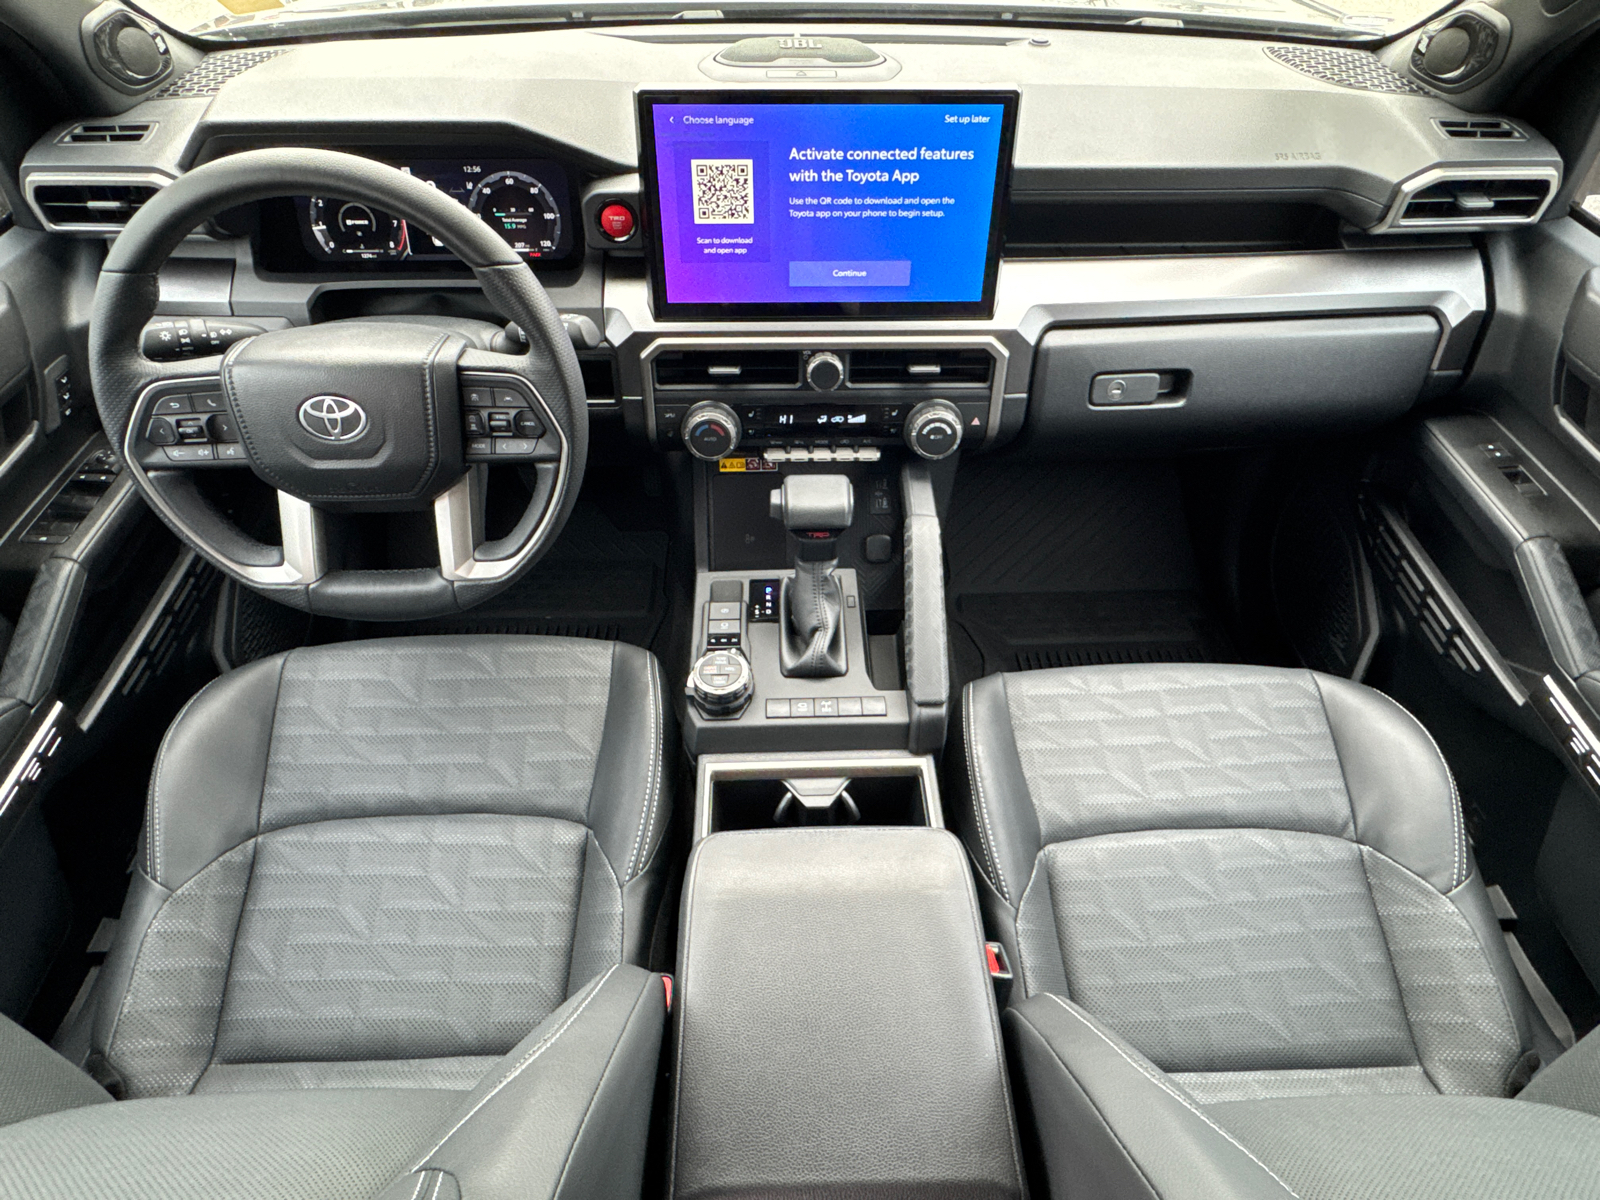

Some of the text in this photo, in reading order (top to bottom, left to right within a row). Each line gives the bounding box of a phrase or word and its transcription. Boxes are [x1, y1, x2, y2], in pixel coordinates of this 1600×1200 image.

[778, 38, 822, 49] JBL
[683, 115, 754, 127] Choose language
[944, 114, 990, 125] Set up later
[788, 146, 975, 160] Activate connected features
[788, 168, 920, 185] with the Toyota App
[788, 196, 955, 206] Use the QR code to download and open the
[788, 209, 814, 219] Toyota
[815, 211, 831, 219] app
[843, 211, 861, 219] your
[861, 209, 887, 219] phone
[898, 209, 920, 219] begin
[921, 210, 945, 219] setup.
[392, 220, 398, 228] 7
[696, 236, 713, 245] Scan
[720, 236, 754, 244] download
[703, 246, 716, 254] and
[832, 269, 867, 278] Continue
[778, 414, 794, 425] HI
